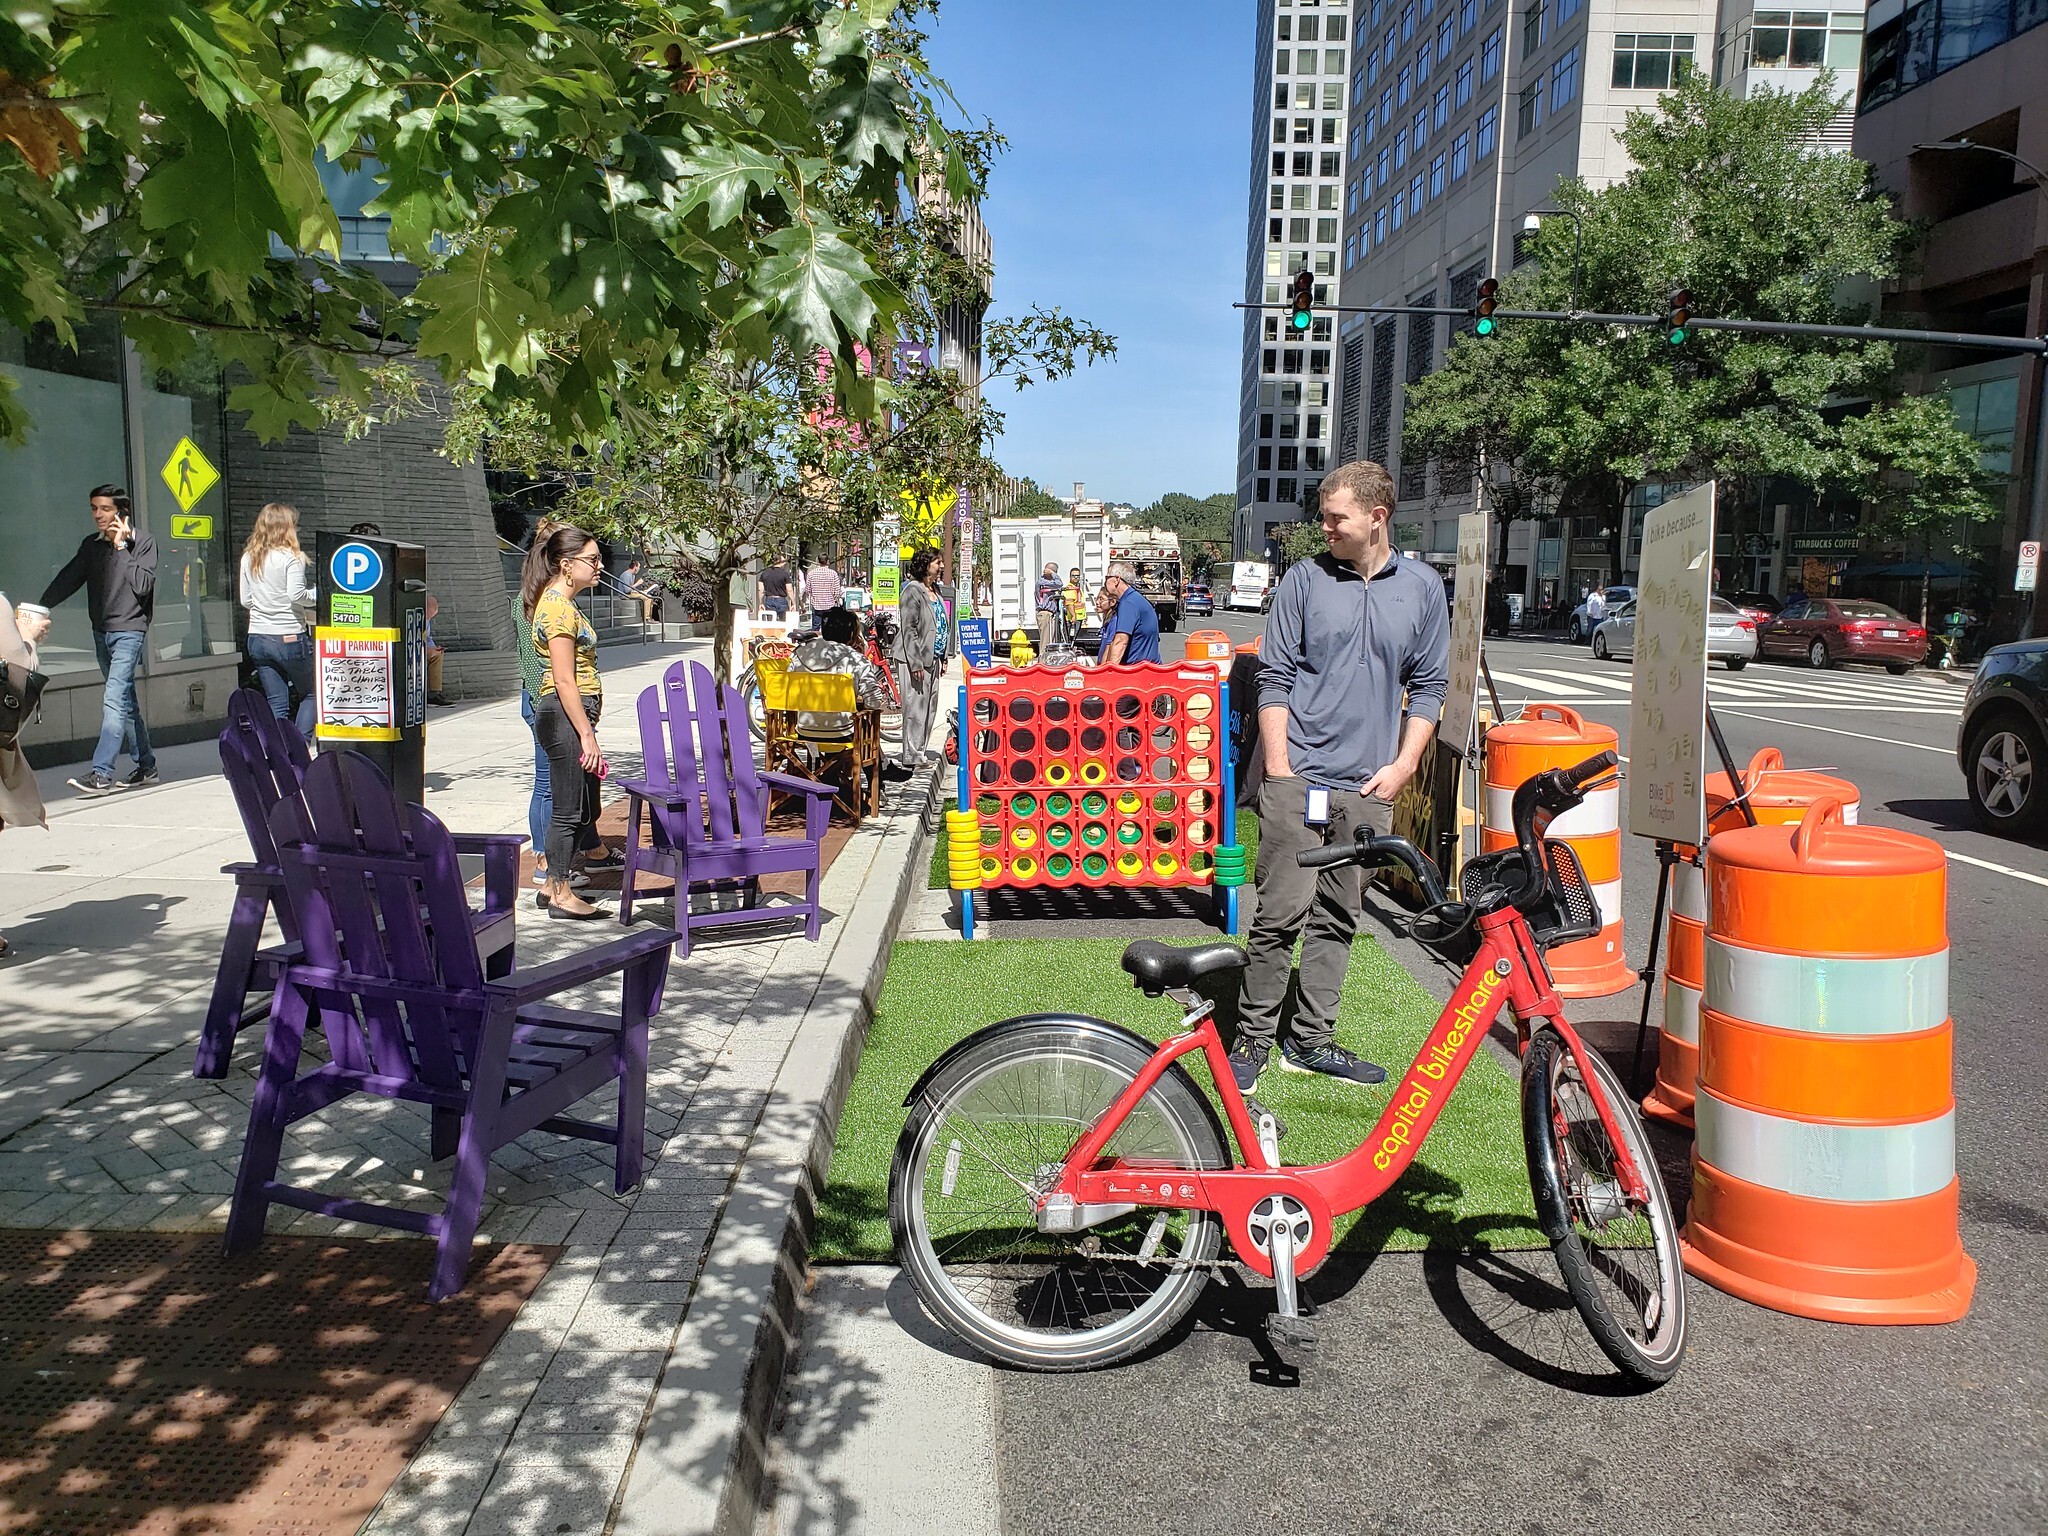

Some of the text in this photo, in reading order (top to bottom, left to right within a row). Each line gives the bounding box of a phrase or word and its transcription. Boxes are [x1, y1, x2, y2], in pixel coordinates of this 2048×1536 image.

[1650, 522, 1665, 544] bike
[1794, 539, 1833, 549] STARBUCKS
[347, 552, 369, 585] P
[333, 613, 360, 623] 54708
[325, 636, 384, 654] NO PARKING
[325, 674, 347, 682] AND
[347, 666, 386, 675] TABLE
[1649, 783, 1664, 801] Bike
[1649, 804, 1675, 824] Arlington
[1373, 968, 1502, 1171] capital bikeshare
